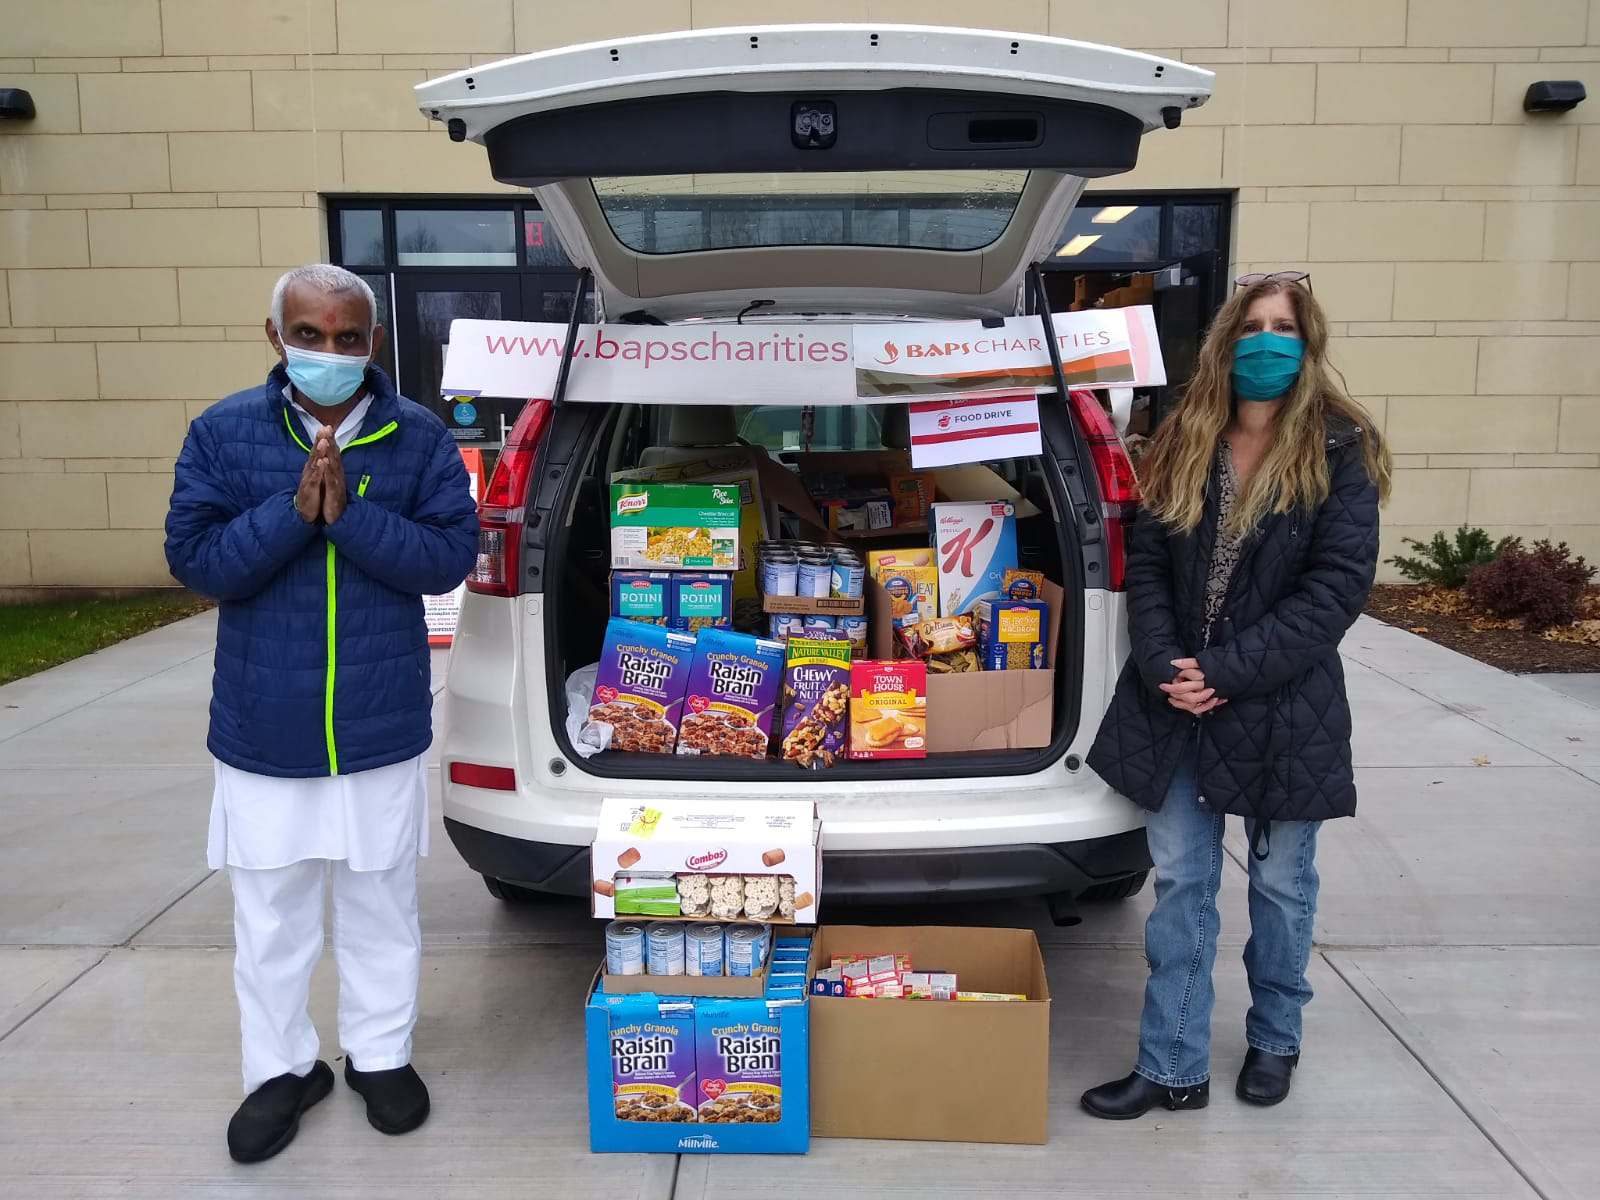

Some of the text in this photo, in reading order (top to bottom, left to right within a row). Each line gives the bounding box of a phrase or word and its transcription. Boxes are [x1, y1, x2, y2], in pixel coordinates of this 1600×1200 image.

[906, 330, 1111, 358] BAPSCHARTIES
[954, 410, 1013, 423] FOOD DRIVE
[618, 498, 646, 510] Knorr
[941, 518, 994, 578] K
[916, 582, 935, 596] EAT
[621, 592, 662, 603] ROTINI
[681, 593, 721, 604] ROTINI
[616, 644, 679, 665] Crunchy Granola
[792, 647, 846, 660] NATURE VALLEY
[619, 653, 672, 677] Raisin
[706, 652, 769, 671] Crunchy Granola
[622, 671, 662, 689] Bran
[710, 661, 762, 685] Raisin
[793, 666, 838, 682] CHEWY
[873, 675, 903, 684] TOWN
[713, 679, 754, 697] Bran
[793, 682, 820, 691] FRUIT
[873, 683, 904, 692] HOUSE
[800, 691, 821, 699] NUT
[689, 851, 724, 866] Combos
[610, 1023, 679, 1037] runchy Granola
[711, 1022, 781, 1037] Crunchy Grano
[611, 1036, 673, 1056] Raisin
[719, 1036, 781, 1055] Raisin
[619, 1053, 667, 1074] Bran
[727, 1053, 774, 1074] Bran
[678, 1138, 719, 1149] Millville
